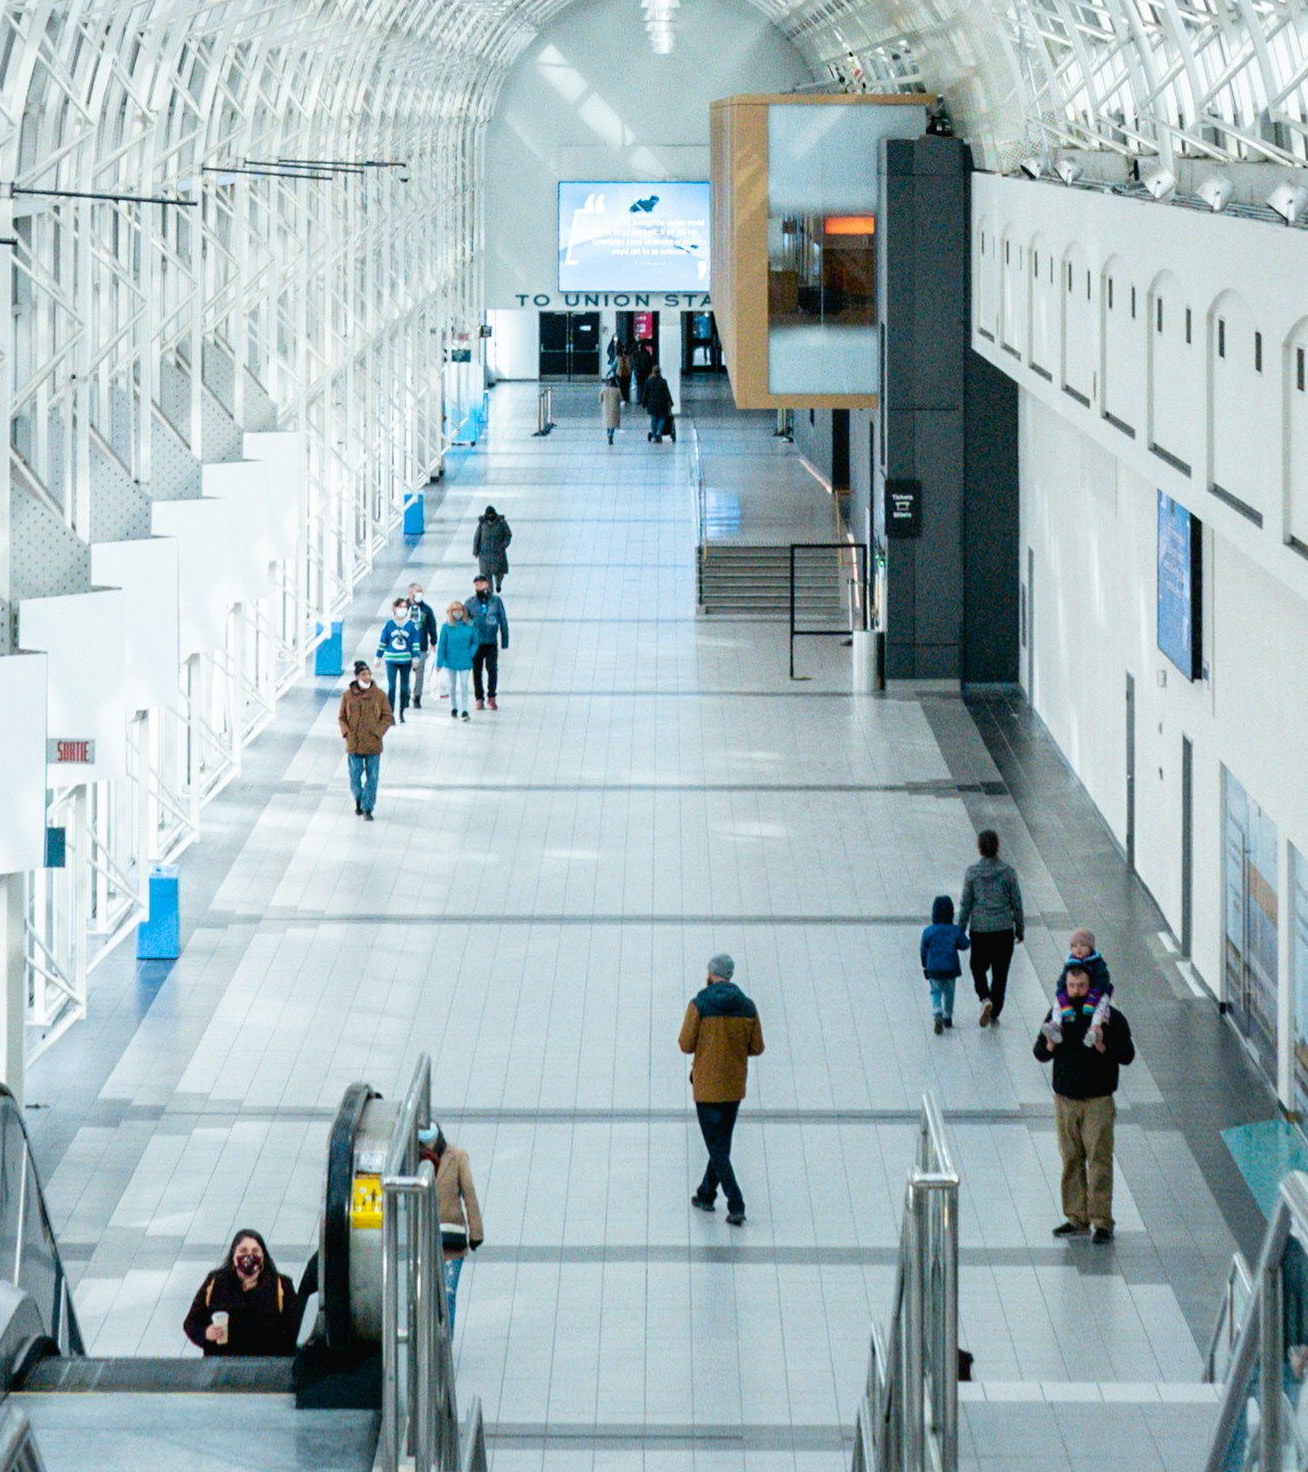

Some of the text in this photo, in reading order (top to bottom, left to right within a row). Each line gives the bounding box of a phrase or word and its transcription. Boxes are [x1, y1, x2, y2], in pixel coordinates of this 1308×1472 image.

[515, 293, 550, 307] TO
[564, 293, 650, 307] UNION
[57, 741, 89, 762] SORTIE
